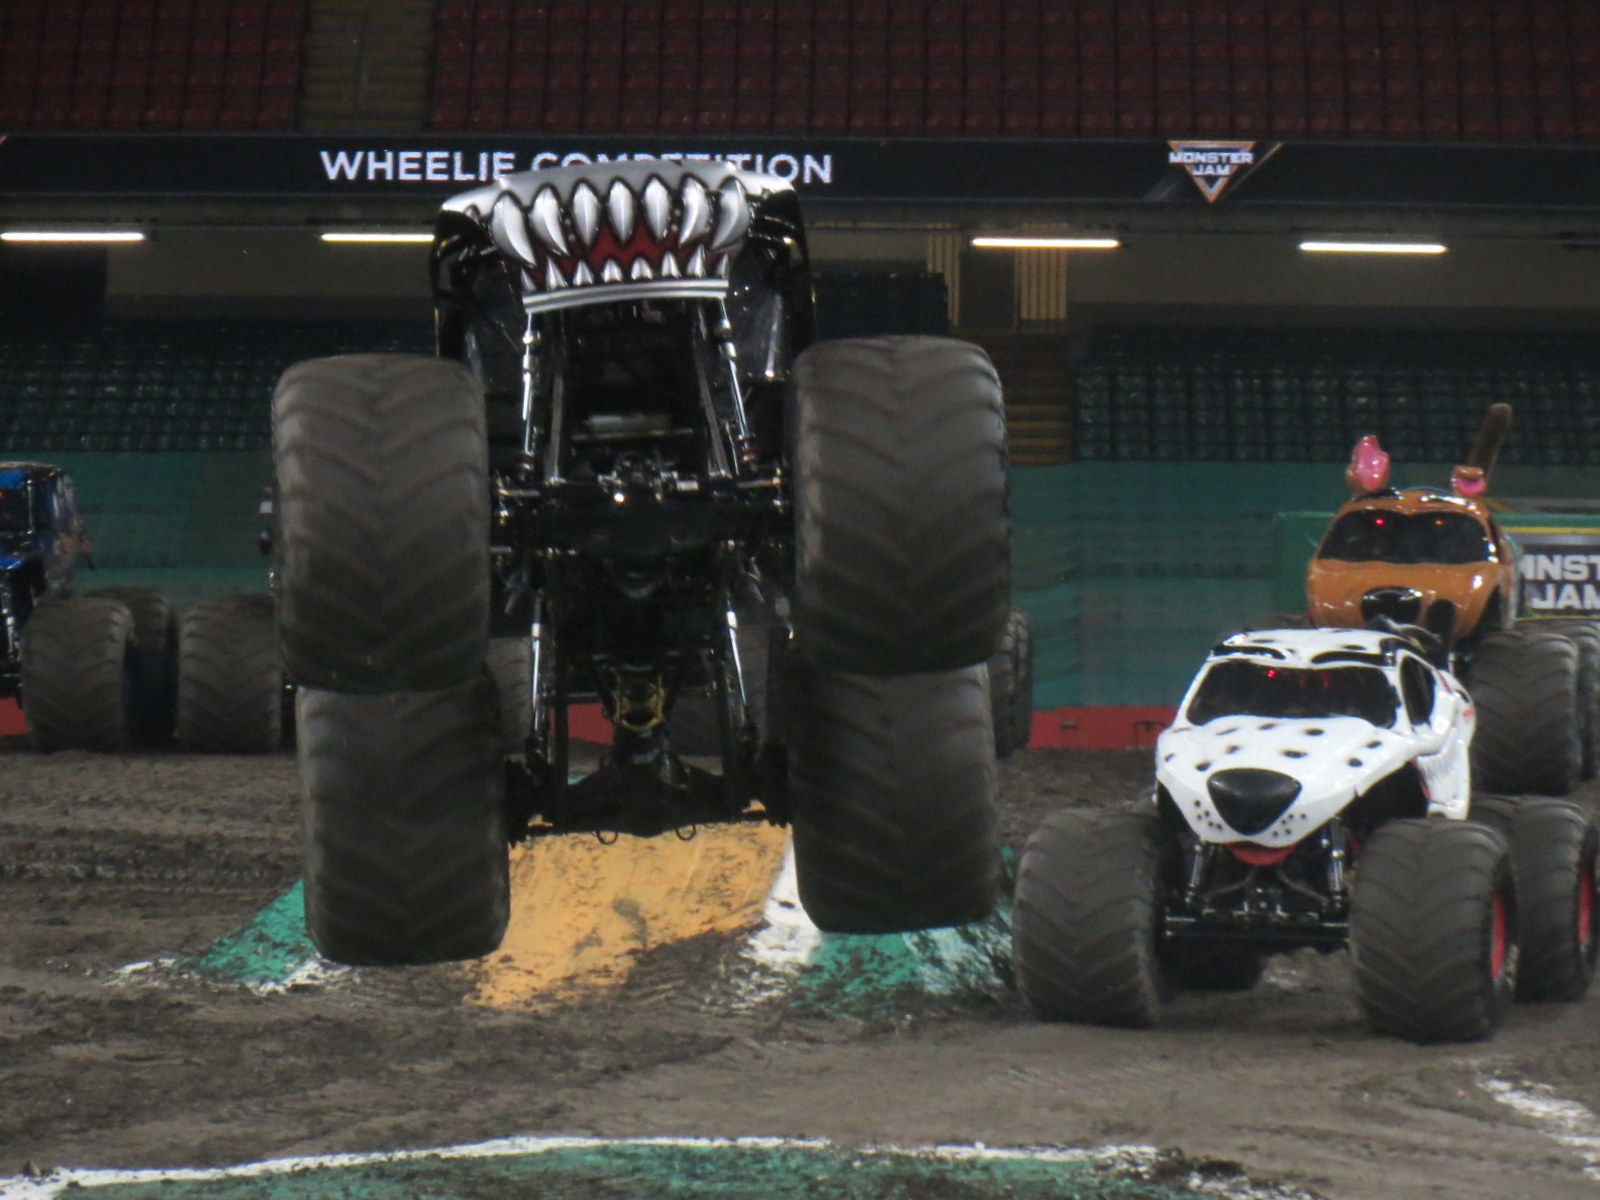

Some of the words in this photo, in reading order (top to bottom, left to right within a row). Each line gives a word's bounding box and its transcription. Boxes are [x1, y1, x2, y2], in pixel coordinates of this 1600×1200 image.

[1168, 152, 1253, 163] MONSTER
[319, 151, 516, 181] WHEELIE
[1192, 165, 1230, 175] JAM
